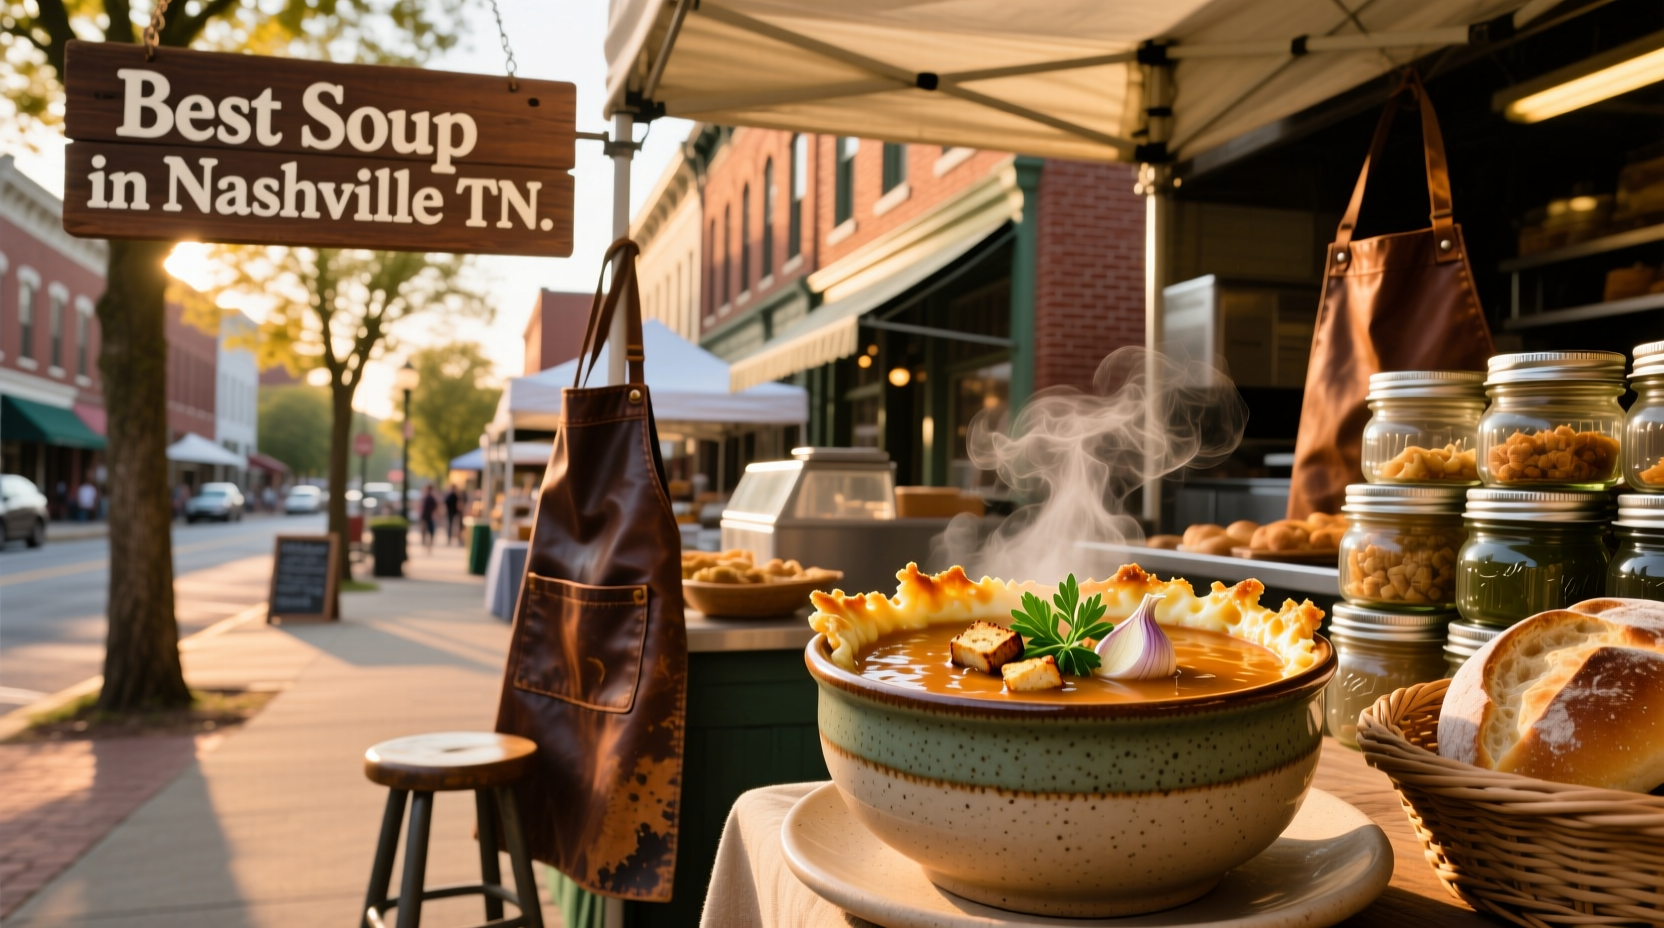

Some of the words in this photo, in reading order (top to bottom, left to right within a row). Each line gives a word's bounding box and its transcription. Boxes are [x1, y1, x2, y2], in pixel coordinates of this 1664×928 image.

[116, 68, 283, 147] Best
[301, 81, 478, 175] Soup
[86, 154, 150, 211] in
[163, 156, 444, 225] Nashville
[455, 177, 554, 232] TN.
